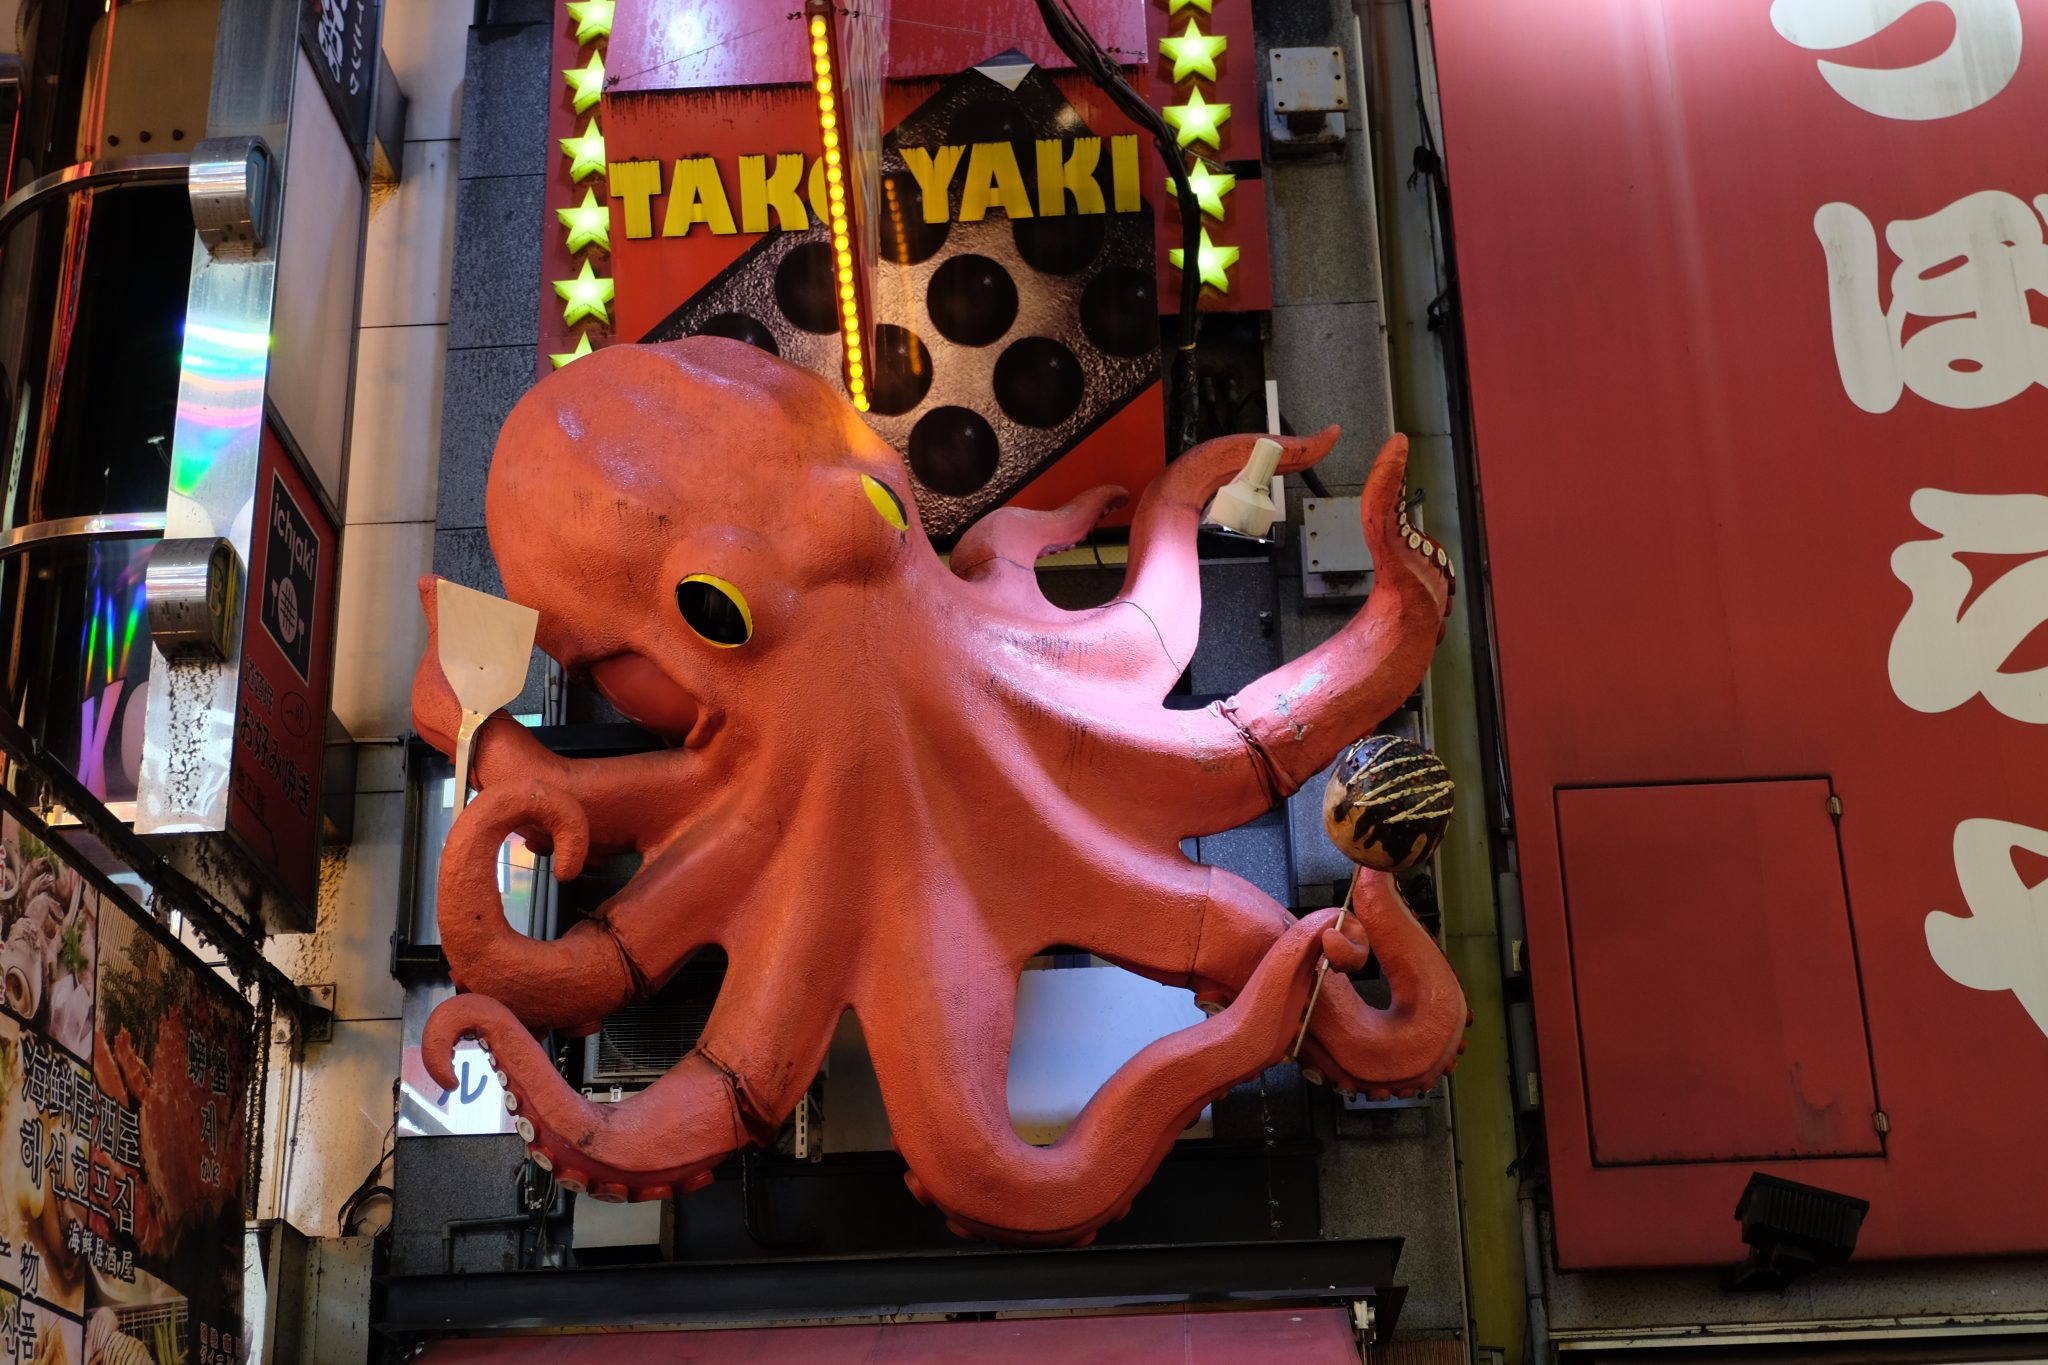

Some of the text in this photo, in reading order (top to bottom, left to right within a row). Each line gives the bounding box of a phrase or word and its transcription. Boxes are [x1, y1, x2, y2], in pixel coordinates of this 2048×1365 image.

[239, 701, 310, 816] お好み焼き
[22, 1039, 141, 1168] 海鮮居酒屋
[68, 1222, 136, 1283] 海鮮居酒屋
